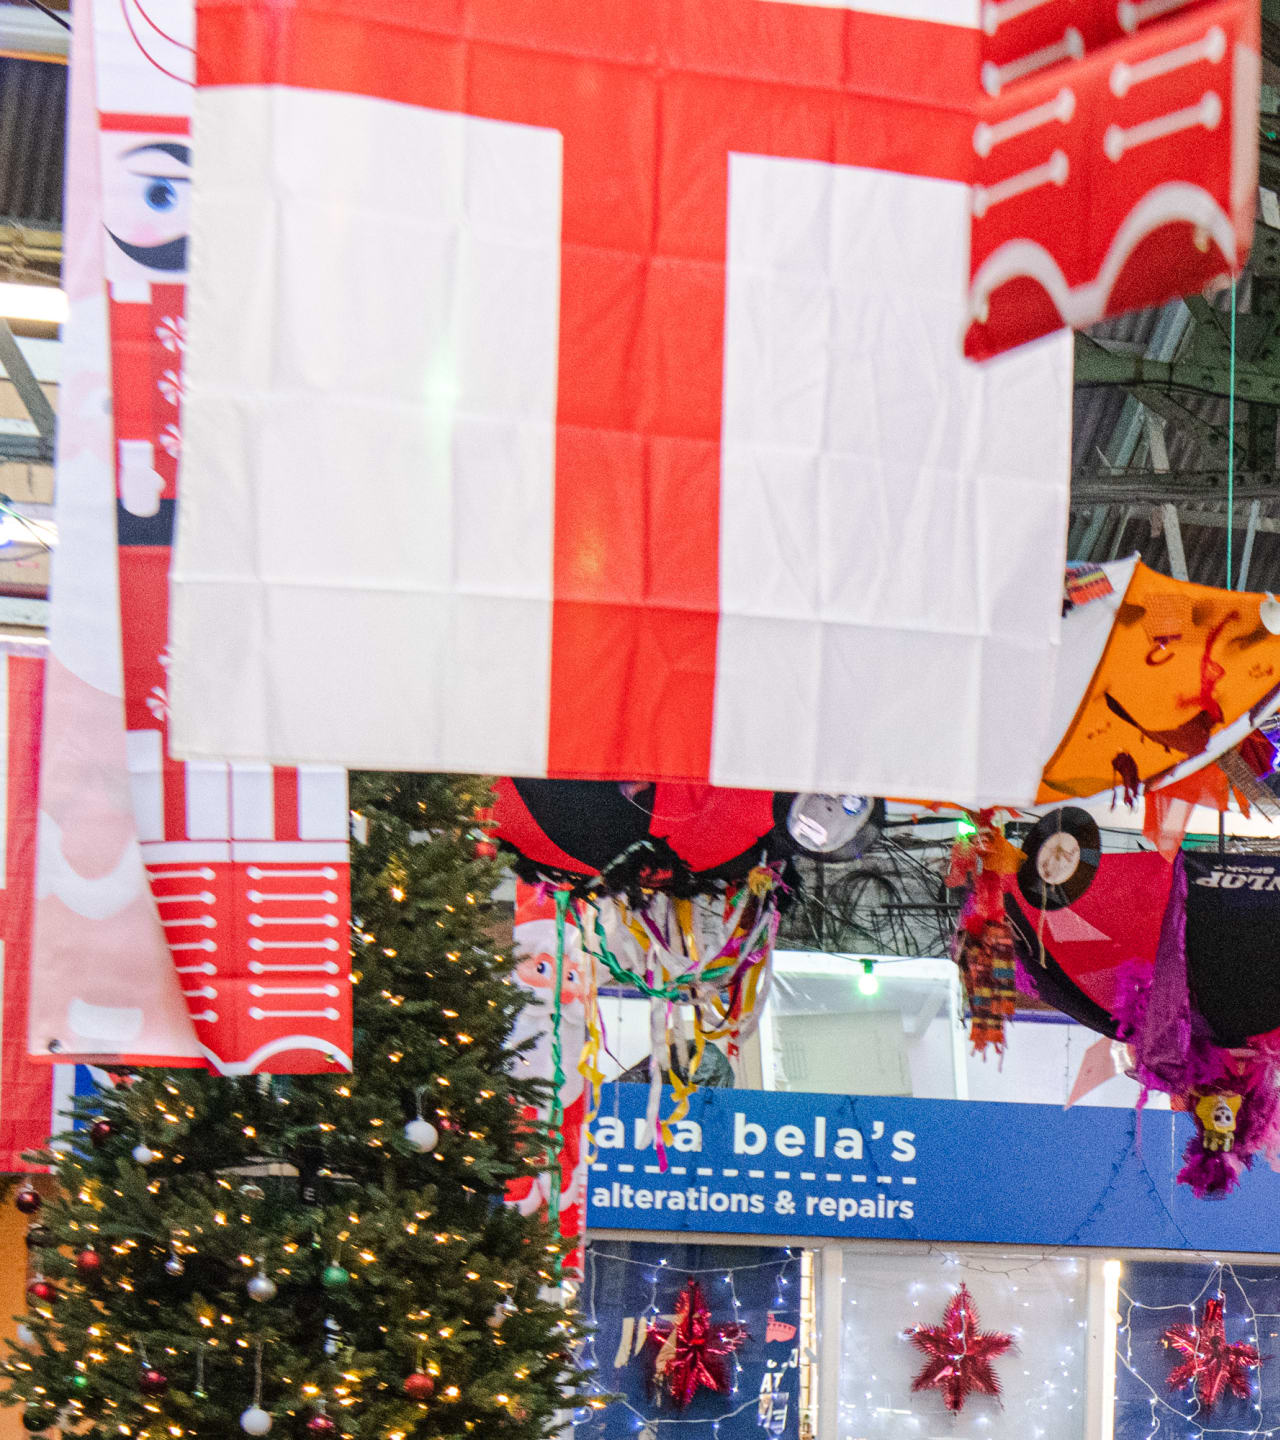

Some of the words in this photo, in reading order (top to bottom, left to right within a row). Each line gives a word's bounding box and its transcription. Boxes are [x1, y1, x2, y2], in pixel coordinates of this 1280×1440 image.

[591, 1181, 766, 1214] alterations
[774, 1189, 797, 1215] &
[805, 1192, 915, 1222] repairs
